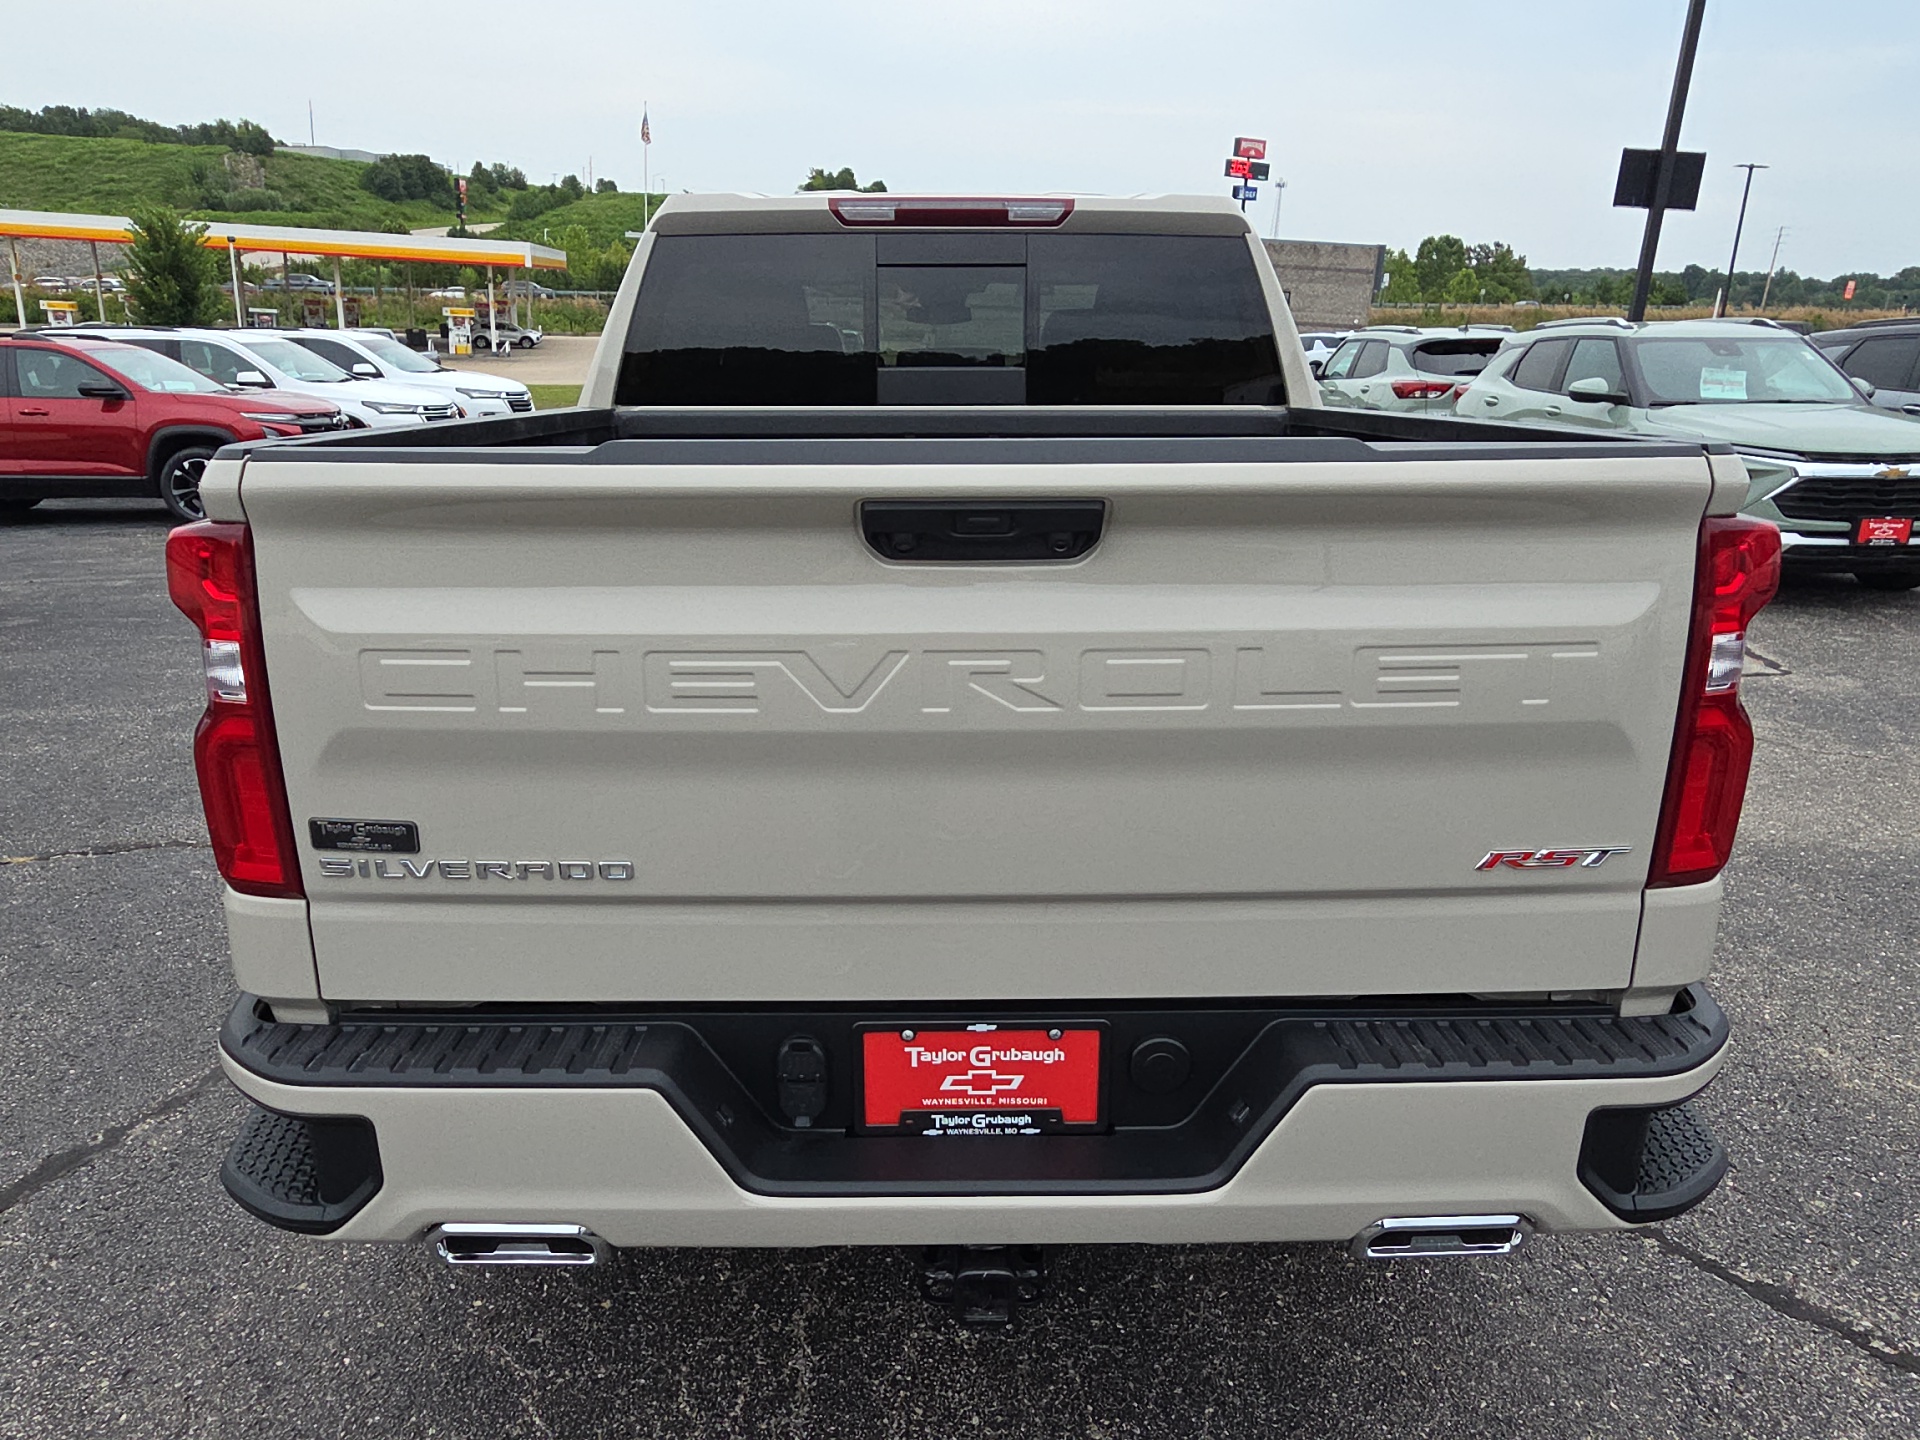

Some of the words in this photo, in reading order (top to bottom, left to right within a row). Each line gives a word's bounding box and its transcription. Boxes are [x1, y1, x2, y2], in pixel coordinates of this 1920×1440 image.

[358, 641, 1599, 714] CHEVROLET
[317, 821, 352, 835] Taylor
[353, 822, 407, 836] Grubaugh
[1475, 845, 1632, 870] RST
[319, 857, 636, 881] SILVERADO
[904, 1046, 966, 1067] Taylor
[969, 1046, 1065, 1066] Grubaugh
[921, 1097, 996, 1106] WAYNESVILLE,
[998, 1097, 1048, 1105] MISSOURI
[931, 1114, 970, 1128] Taylor
[972, 1114, 1032, 1127] Grubaugh
[946, 1127, 1002, 1135] WAYNESVILLE,
